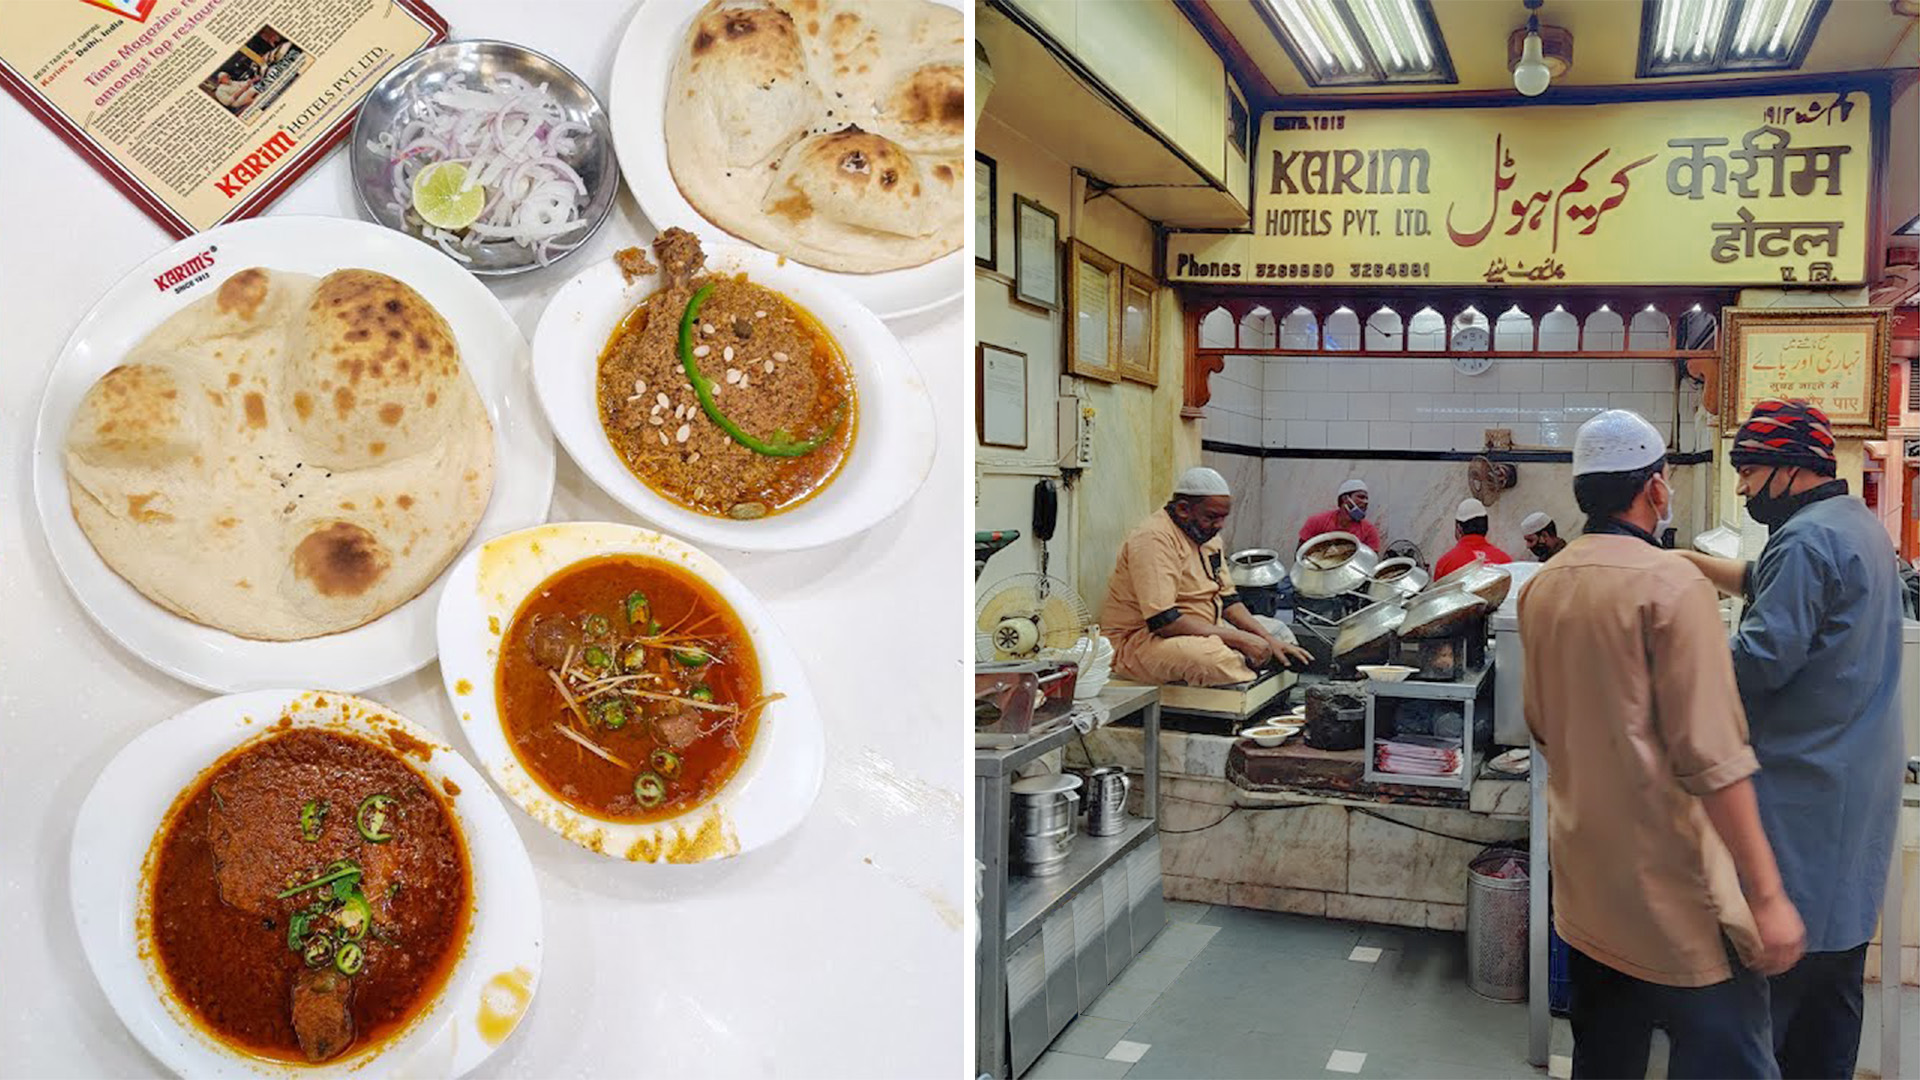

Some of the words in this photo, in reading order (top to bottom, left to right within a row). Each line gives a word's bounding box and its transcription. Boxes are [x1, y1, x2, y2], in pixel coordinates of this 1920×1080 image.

[84, 58, 121, 87] Time
[117, 7, 181, 61] Magazine
[100, 19, 124, 37] India
[32, 65, 50, 80] BEST
[49, 49, 70, 66] TASTE
[67, 40, 78, 51] OF
[94, 57, 151, 107] amongst
[148, 40, 174, 62] top
[286, 88, 336, 135] HOTELS
[333, 66, 363, 96] PVT.
[358, 45, 388, 74] LTD.
[1270, 148, 1431, 195] KARIM
[1446, 132, 1553, 247] ہوٹل
[1666, 125, 1852, 200] करीम
[1265, 209, 1332, 237] HOTELS
[1342, 209, 1381, 237] PVT.
[1395, 208, 1432, 237] LTD.
[1552, 147, 1659, 254] کریم
[1711, 206, 1844, 264] होटल
[1177, 253, 1241, 278] Phones
[1790, 352, 1813, 371] اور
